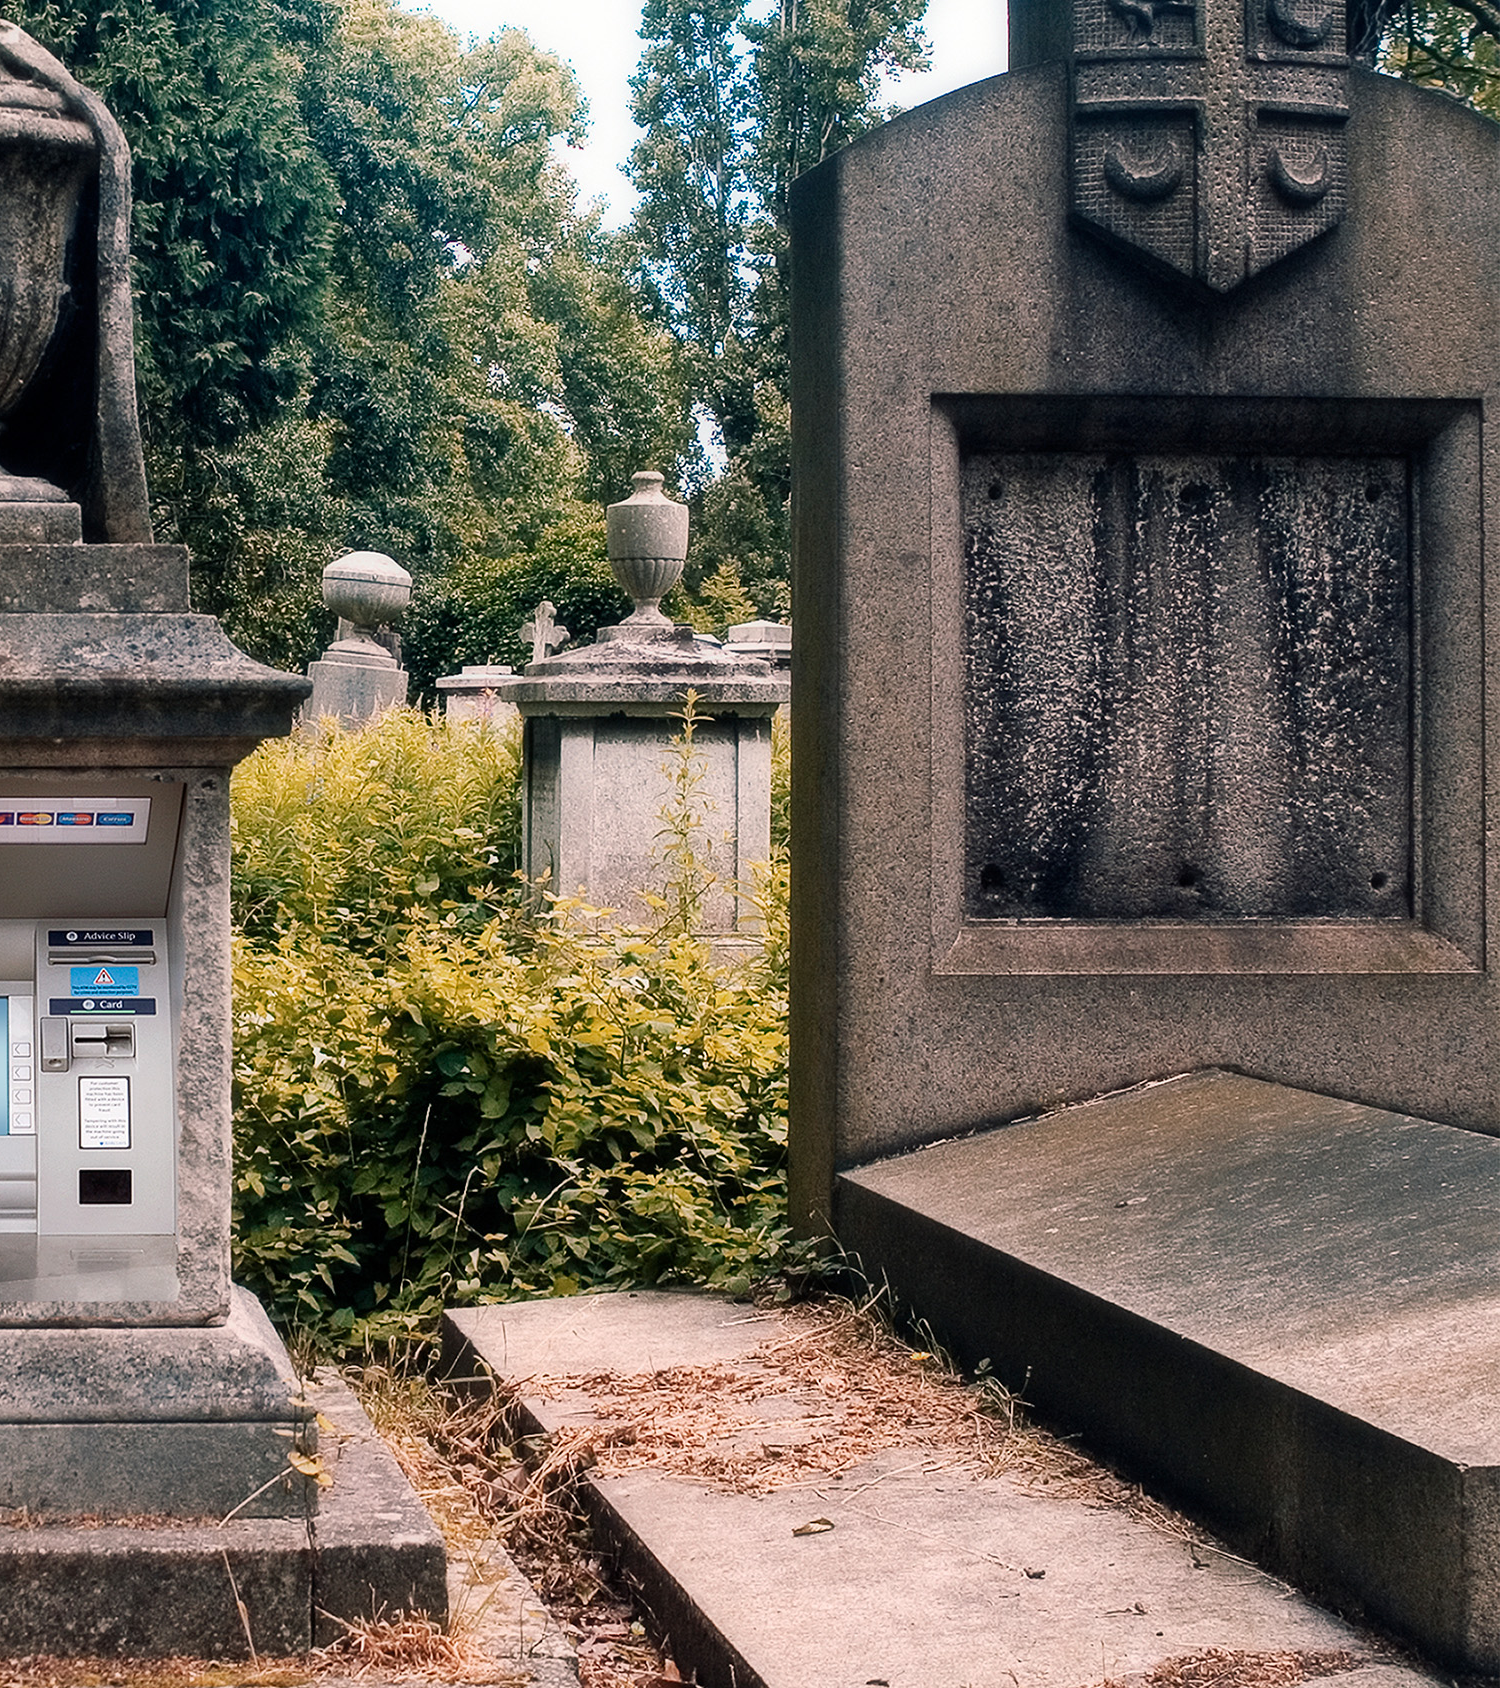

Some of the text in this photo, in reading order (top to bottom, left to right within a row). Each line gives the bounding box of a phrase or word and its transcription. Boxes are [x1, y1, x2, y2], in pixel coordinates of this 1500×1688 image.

[83, 931, 136, 942] Advice Slip
[99, 1000, 123, 1010] Card
